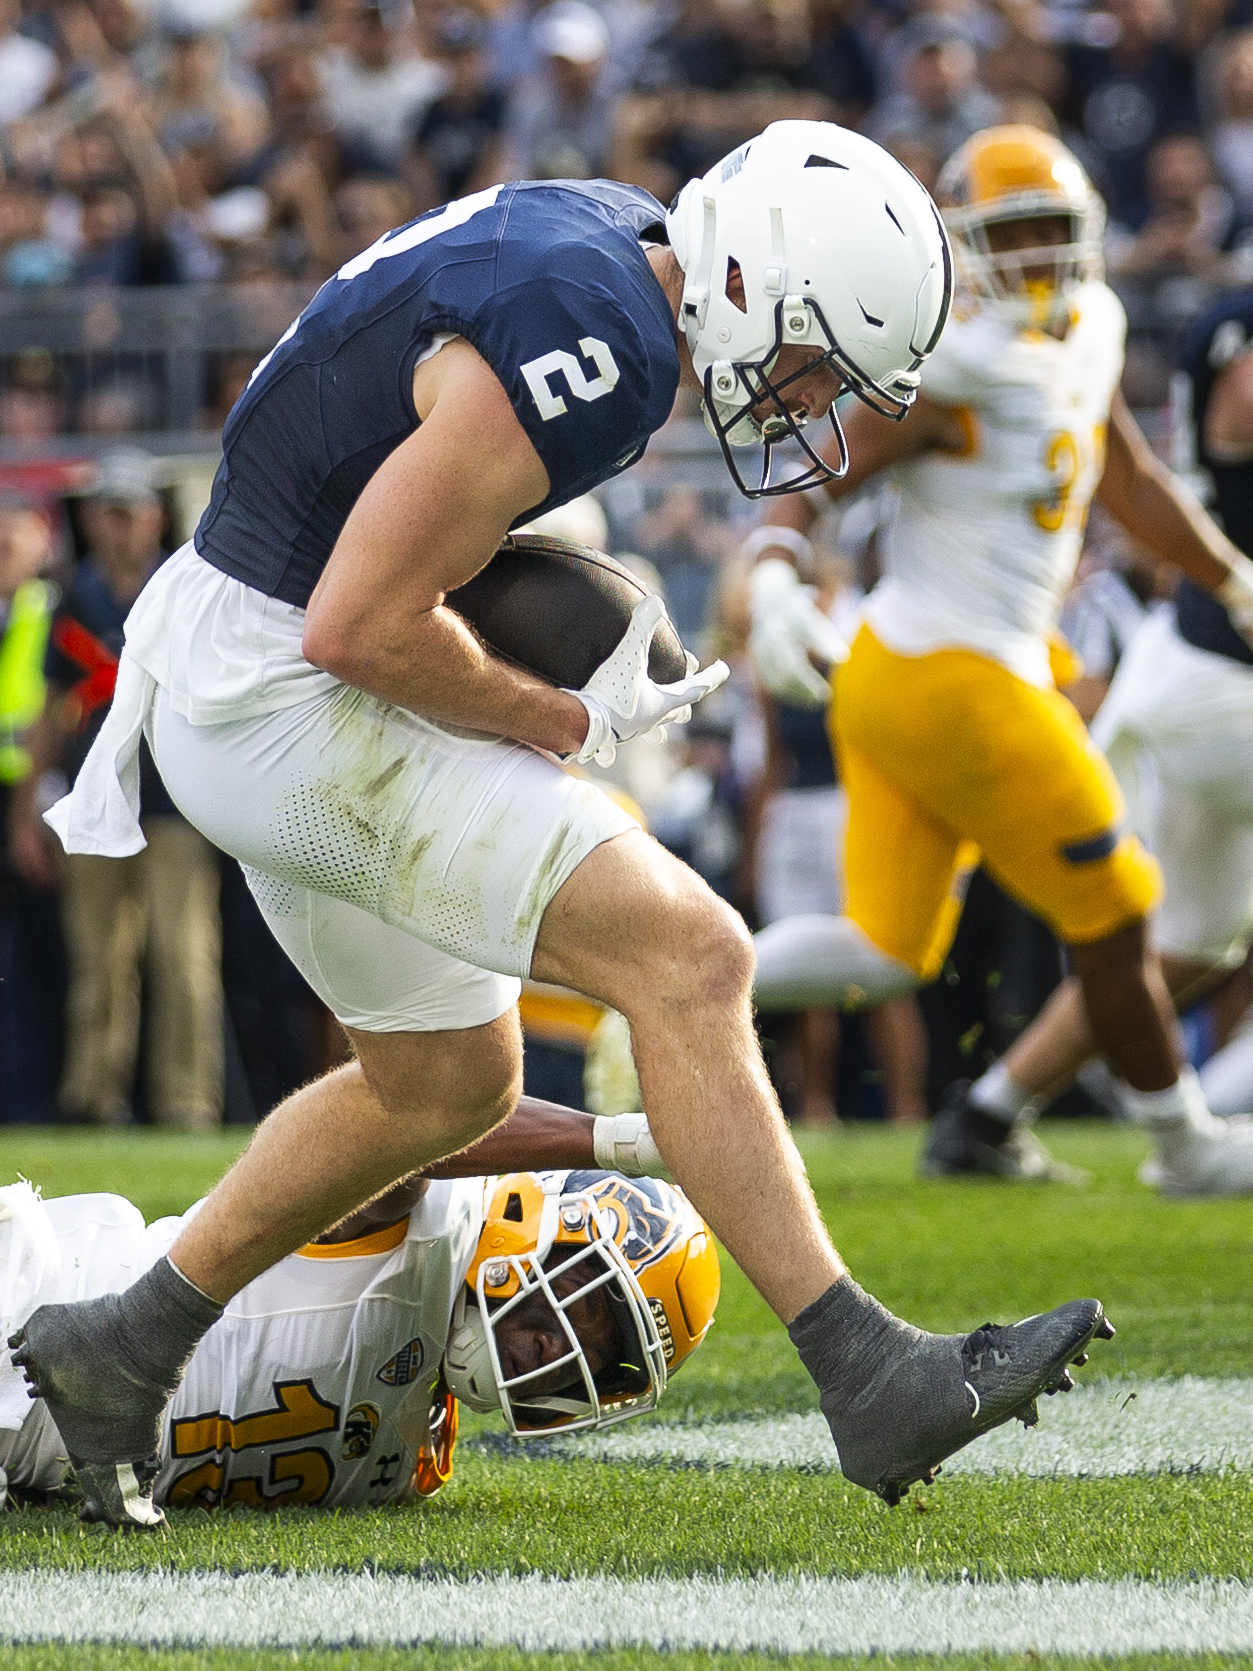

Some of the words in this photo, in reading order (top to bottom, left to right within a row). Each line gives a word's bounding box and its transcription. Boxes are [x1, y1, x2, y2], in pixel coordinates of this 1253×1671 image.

[520, 336, 620, 421] 2
[650, 1302, 675, 1359] SPEED
[395, 1346, 410, 1385] MAC
